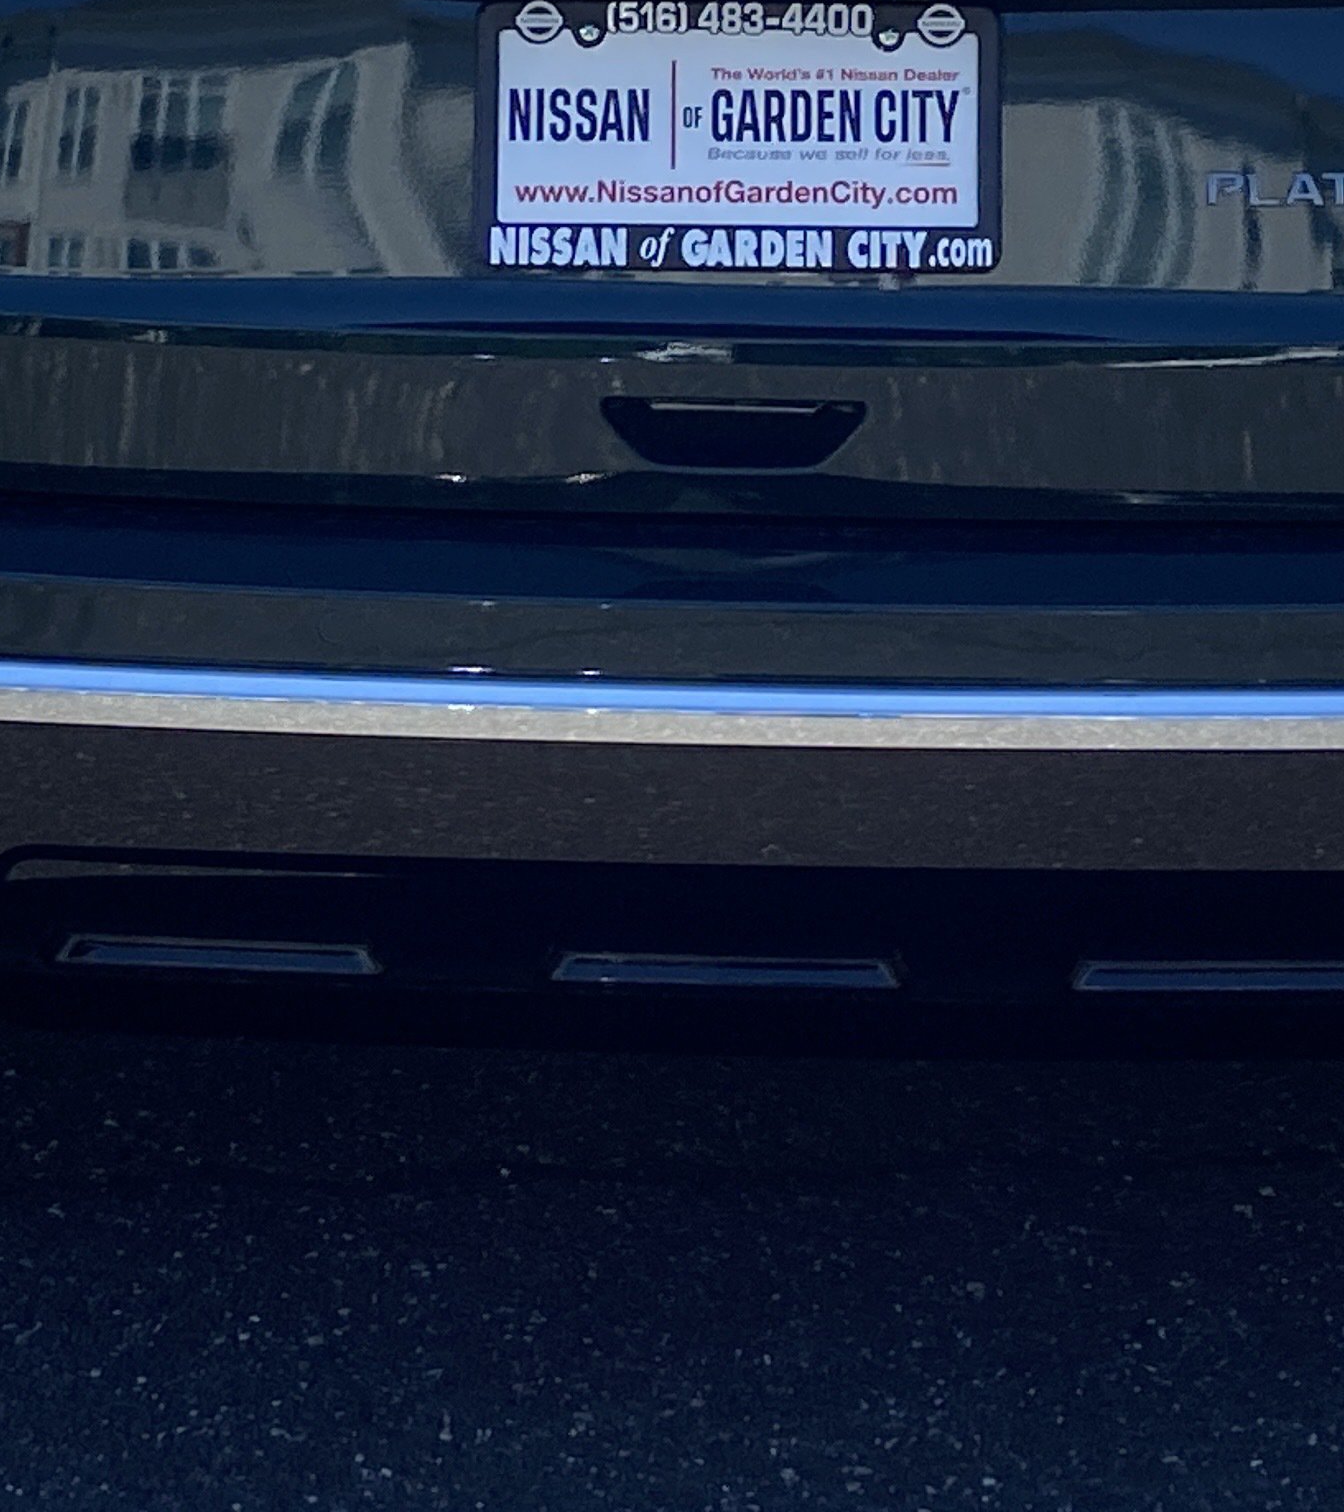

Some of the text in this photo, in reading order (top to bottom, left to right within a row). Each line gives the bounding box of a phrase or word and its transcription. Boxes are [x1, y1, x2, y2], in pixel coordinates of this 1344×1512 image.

[606, 1, 874, 36] (516) 483-4400
[711, 67, 960, 82] The World's #1 Nissan Dealer
[508, 88, 960, 143] NISSAN OF GARDEN CITY
[707, 146, 792, 161] Because
[800, 150, 827, 161] we
[835, 146, 869, 161] sell
[875, 147, 901, 161] for
[514, 179, 958, 210] www.NissanofGardenCity.com
[489, 226, 993, 269] NISSAN of GARDEN CITY.com
